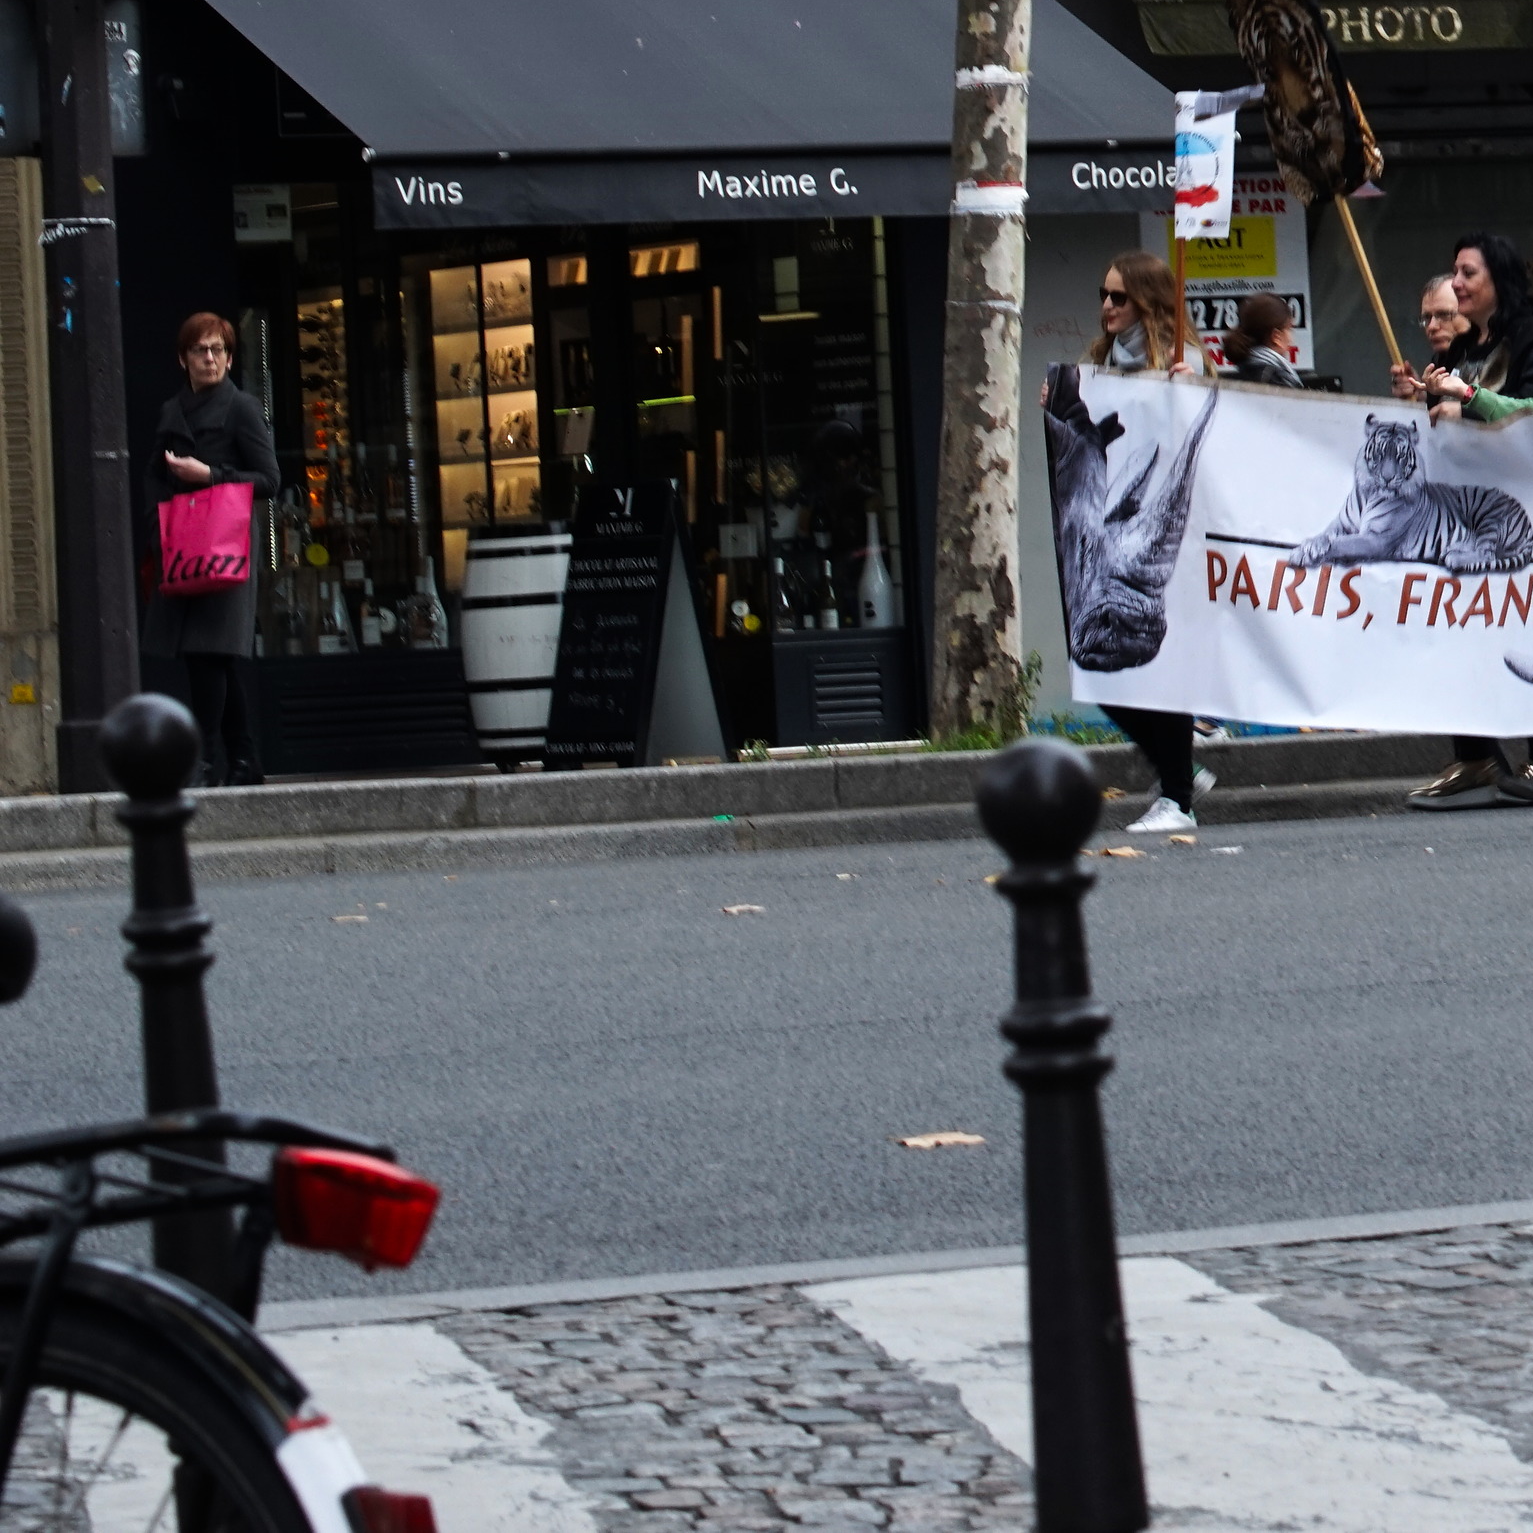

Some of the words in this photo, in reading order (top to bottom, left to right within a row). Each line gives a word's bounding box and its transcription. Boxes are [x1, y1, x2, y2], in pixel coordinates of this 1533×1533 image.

[394, 175, 464, 206] Vins
[697, 169, 817, 200] Maxime
[830, 167, 859, 195] G.
[1071, 160, 1177, 190] Chocola
[1248, 198, 1287, 214] PAR
[1211, 297, 1240, 330] 78
[162, 548, 247, 583] tam
[1206, 549, 1375, 631] PARIS,
